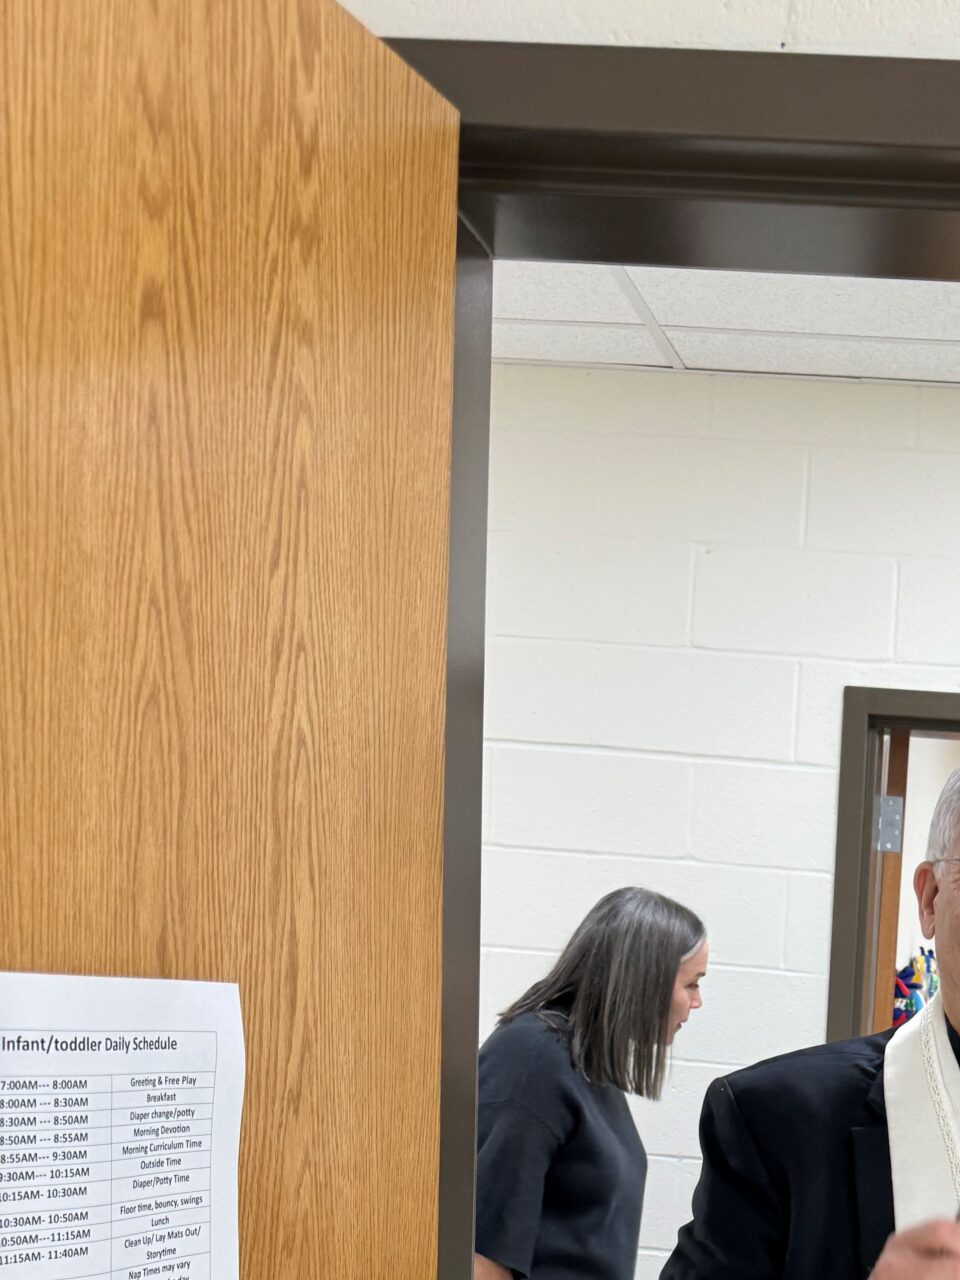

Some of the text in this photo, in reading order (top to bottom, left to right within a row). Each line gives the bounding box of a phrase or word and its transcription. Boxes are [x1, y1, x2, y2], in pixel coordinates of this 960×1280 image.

[2, 1034, 177, 1054] Infant/toddler Daily Schedule
[53, 1080, 88, 1090] 8:00AM
[131, 1075, 197, 1088] Greeting & Free Play
[0, 1098, 36, 1109] 8:00AM
[54, 1097, 88, 1107] 8:30AM
[147, 1092, 176, 1102] Breakfast
[0, 1116, 36, 1127] 8:30AM
[54, 1115, 88, 1126] 8:50AM
[130, 1107, 195, 1122] Diaper change/potty
[133, 1124, 190, 1137] Morning Devotion
[0, 1135, 36, 1146] 8:50AM
[54, 1132, 88, 1144] 8:55AM
[122, 1139, 202, 1155] Morning Curriculum Time
[53, 1150, 87, 1161] 9:30AM
[140, 1157, 182, 1170] Outside Time
[50, 1167, 90, 1179] 10:15AM
[133, 1174, 190, 1189] Diaper/Potty Time
[47, 1186, 87, 1198] 10:30AM
[120, 1205, 136, 1215] Floor
[154, 1199, 179, 1209] bouncy,
[180, 1195, 203, 1206] swings
[48, 1211, 89, 1224] 10:50AM
[151, 1216, 170, 1227] Lunch
[0, 1229, 91, 1248] 0:50AM---11:15AM
[124, 1225, 201, 1248] Clean Up/ Lay Mats Out/
[48, 1246, 89, 1260] 11:40AM
[146, 1247, 176, 1260] Storytime
[128, 1261, 191, 1280] Nap Times may vary
